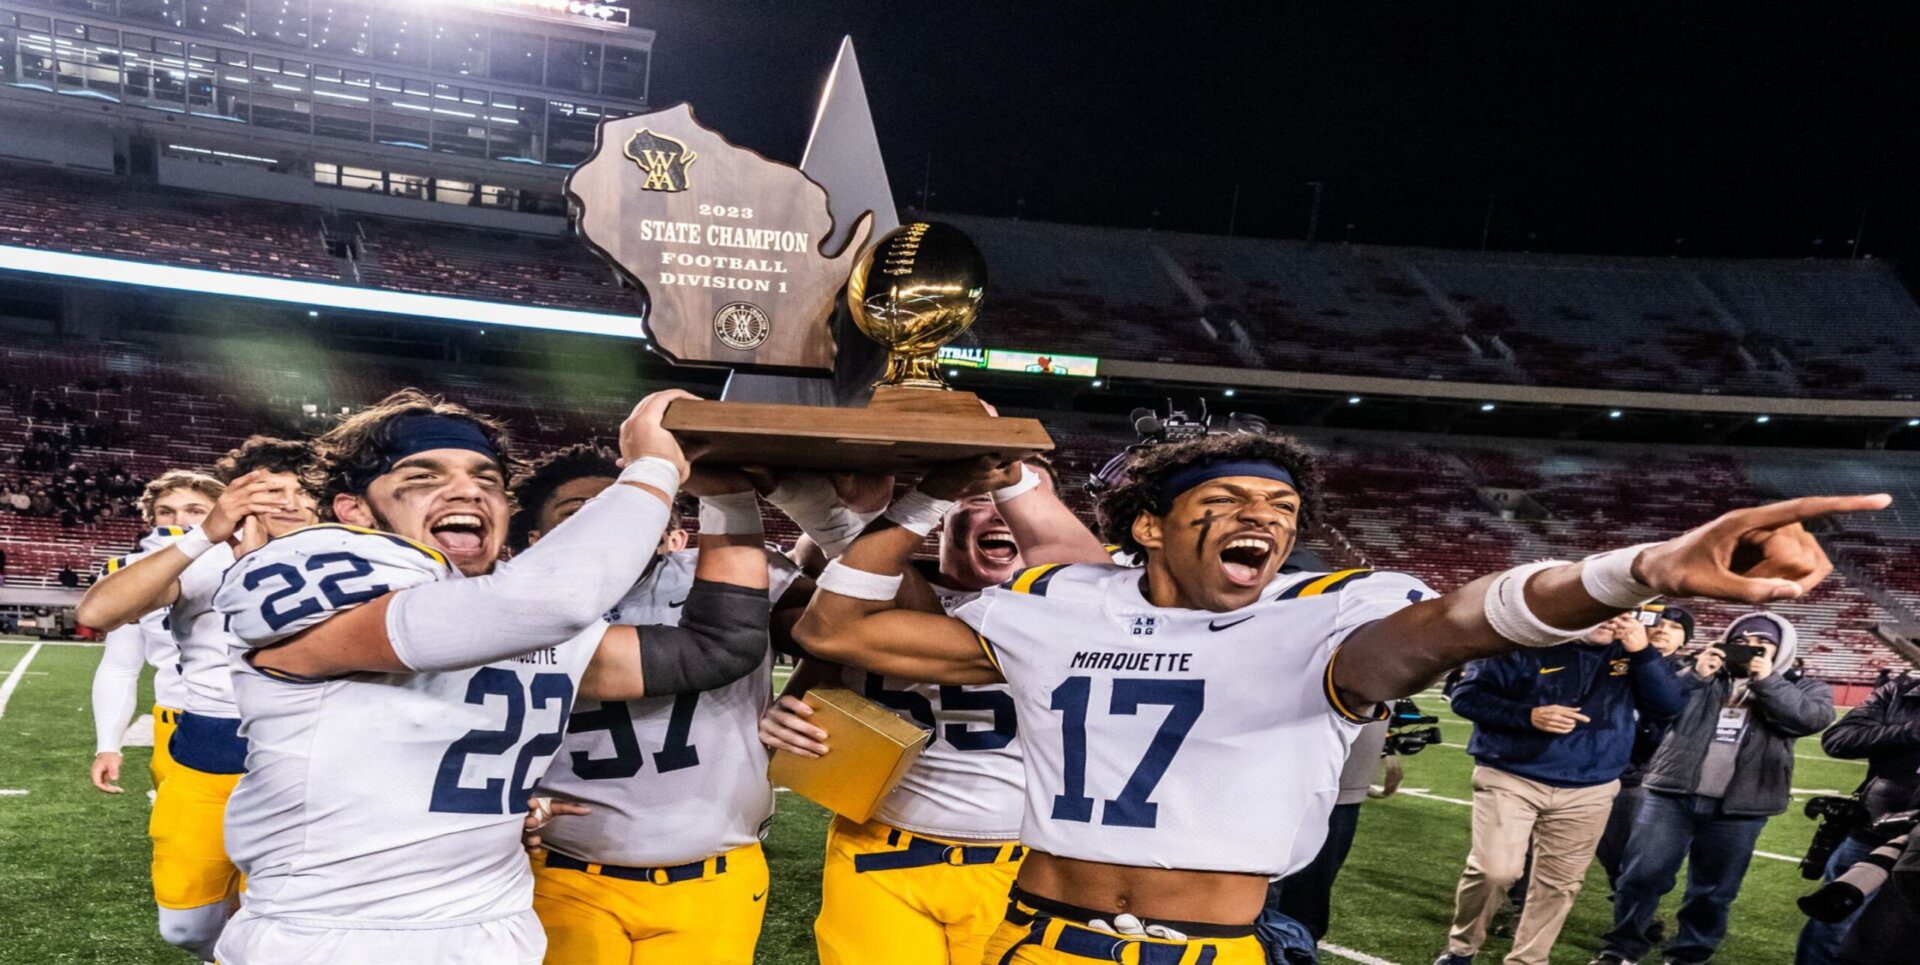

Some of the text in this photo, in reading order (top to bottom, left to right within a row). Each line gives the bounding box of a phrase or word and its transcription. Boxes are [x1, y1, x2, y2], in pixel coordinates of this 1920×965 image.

[699, 204, 754, 219] 2023
[640, 219, 809, 253] STATE CHAMPION
[661, 252, 788, 273] FOOTBALL
[660, 272, 788, 293] DIVISION 1
[243, 551, 390, 631] 22
[1071, 652, 1193, 671] MARQUETTE
[429, 666, 574, 815] 22
[1050, 676, 1205, 828] 17
